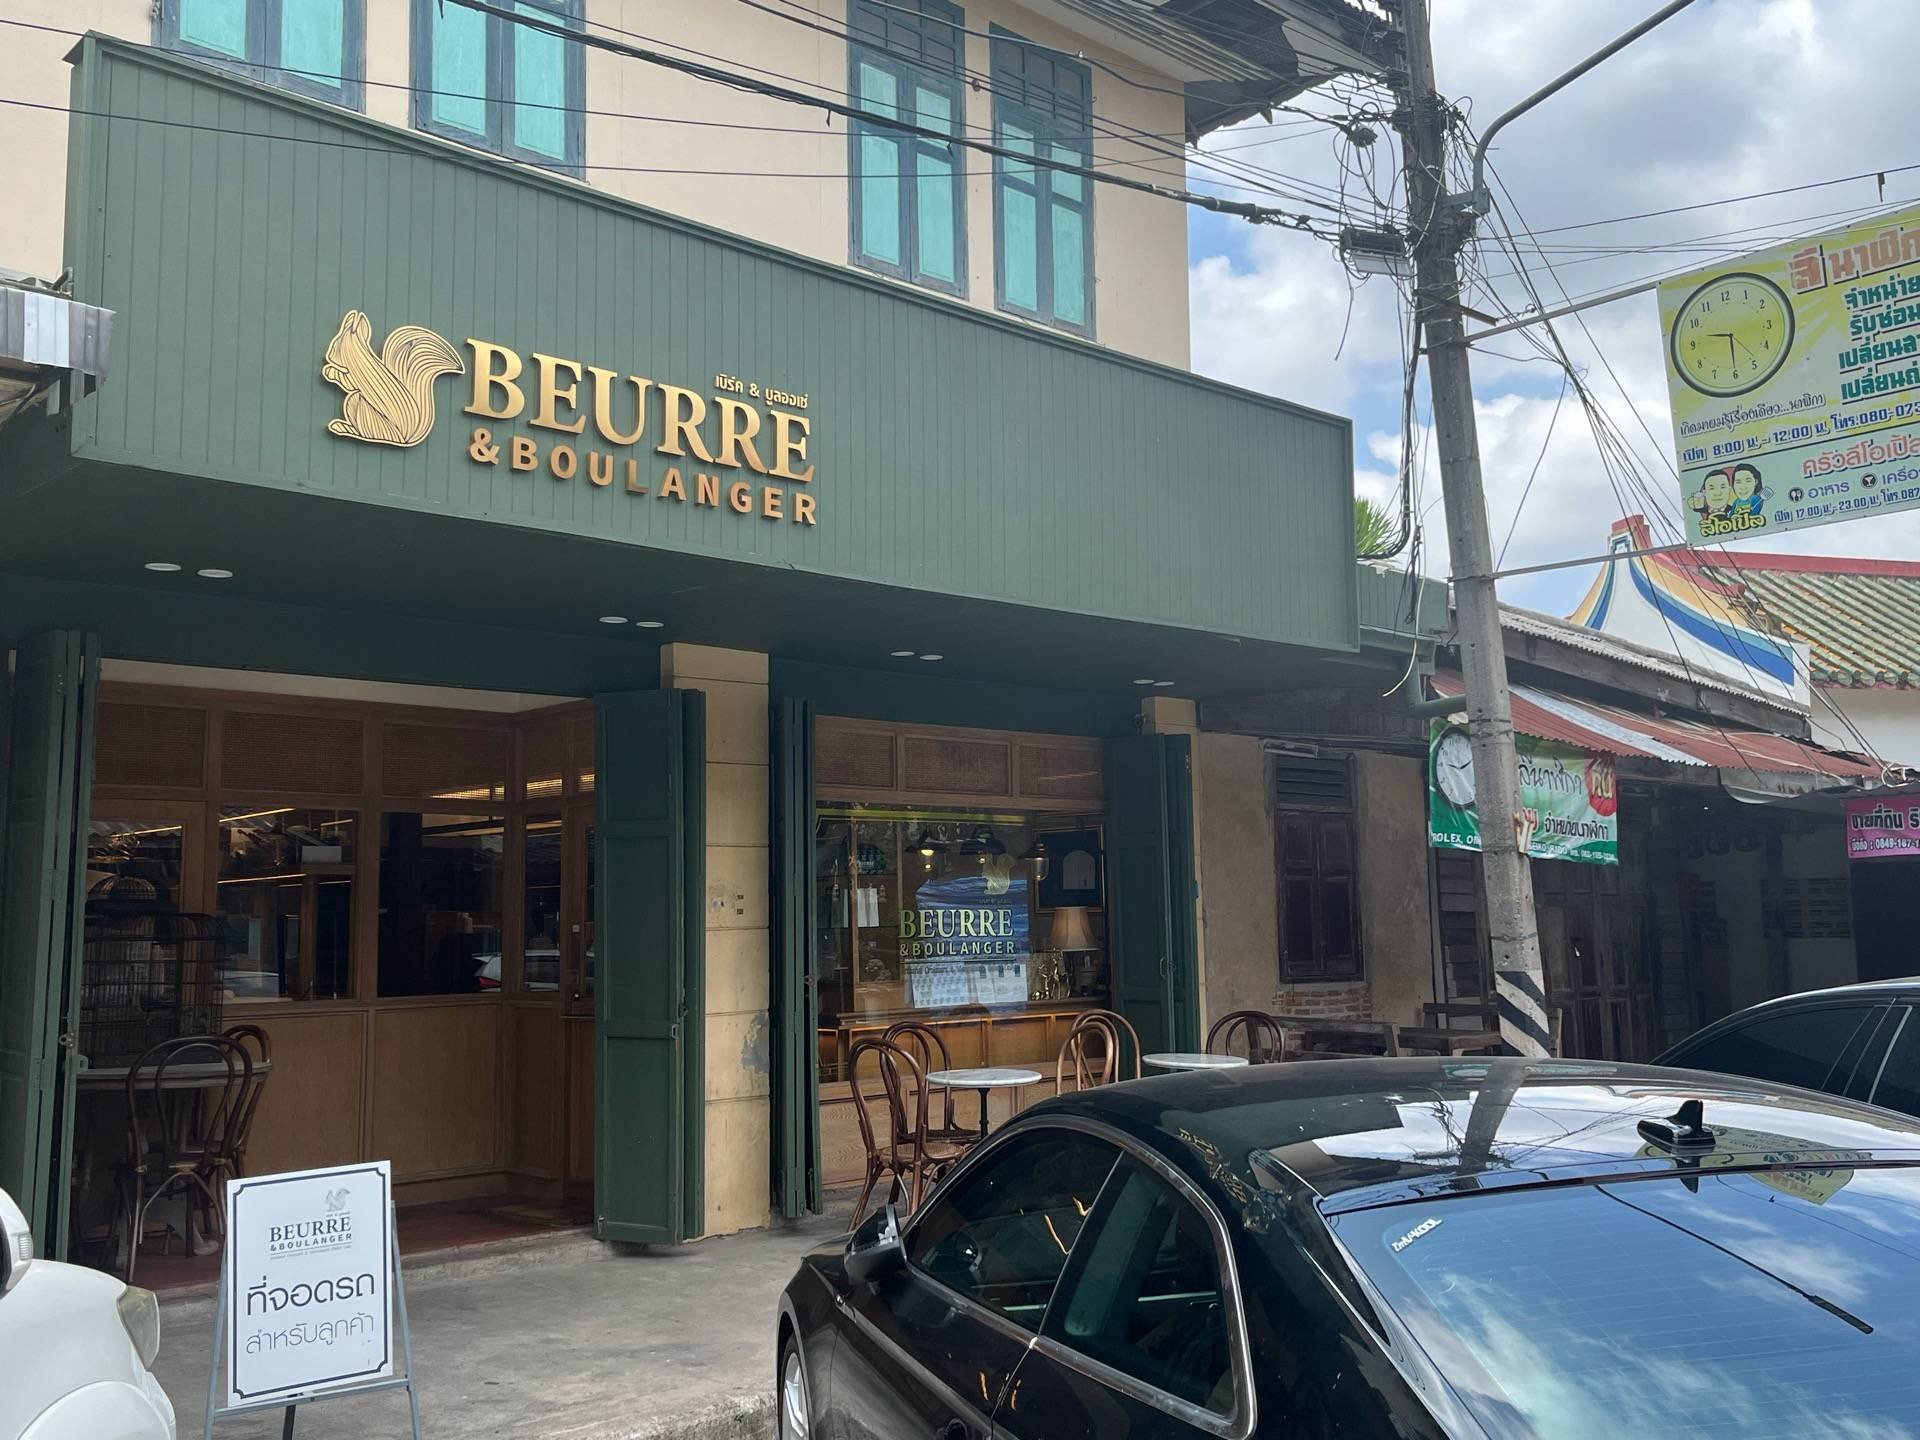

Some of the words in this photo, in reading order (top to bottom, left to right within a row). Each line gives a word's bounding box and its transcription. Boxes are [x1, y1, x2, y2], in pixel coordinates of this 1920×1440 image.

[1720, 290, 1730, 302] 12
[1701, 301, 1711, 313] 11
[1759, 299, 1765, 310] 2
[1690, 318, 1699, 329] 10
[1766, 319, 1772, 330] 3
[1690, 340, 1696, 350] 9
[1763, 340, 1769, 350] 4
[1697, 359, 1703, 369] 8
[1751, 360, 1758, 370] 5
[1711, 369, 1717, 380] 7
[1732, 369, 1739, 380] 6
[749, 382, 760, 398] &
[464, 338, 814, 483] BEURRE
[1808, 482, 1849, 498] อาหาร
[1883, 465, 1920, 485] เครื่อ
[898, 908, 1014, 938] BEURRE
[269, 1217, 351, 1242] BEURRE
[247, 1273, 375, 1316] ที่จอดรถ
[246, 1312, 374, 1354] สำหรับลูกค้า
